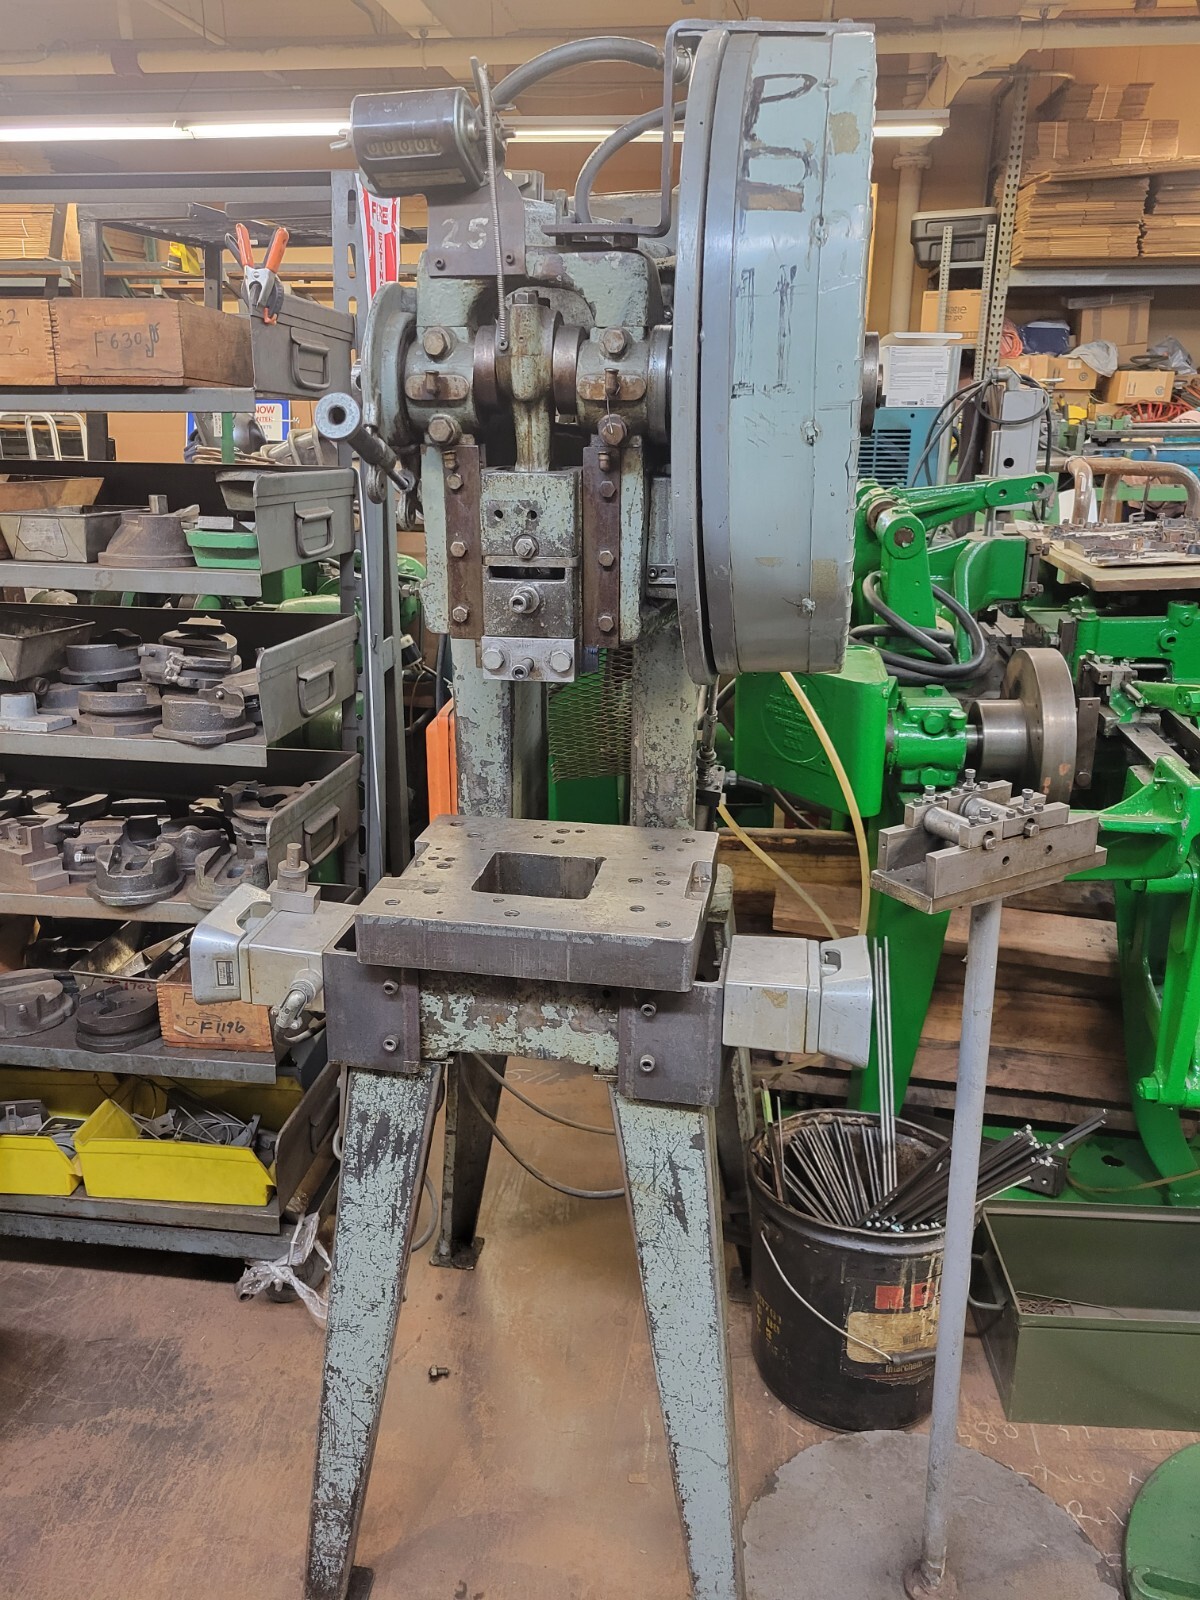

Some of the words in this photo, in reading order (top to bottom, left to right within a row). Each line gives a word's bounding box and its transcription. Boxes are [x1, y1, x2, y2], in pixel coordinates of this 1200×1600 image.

[441, 217, 489, 249] 25
[94, 331, 142, 357] F630
[200, 1021, 245, 1034] F1196
